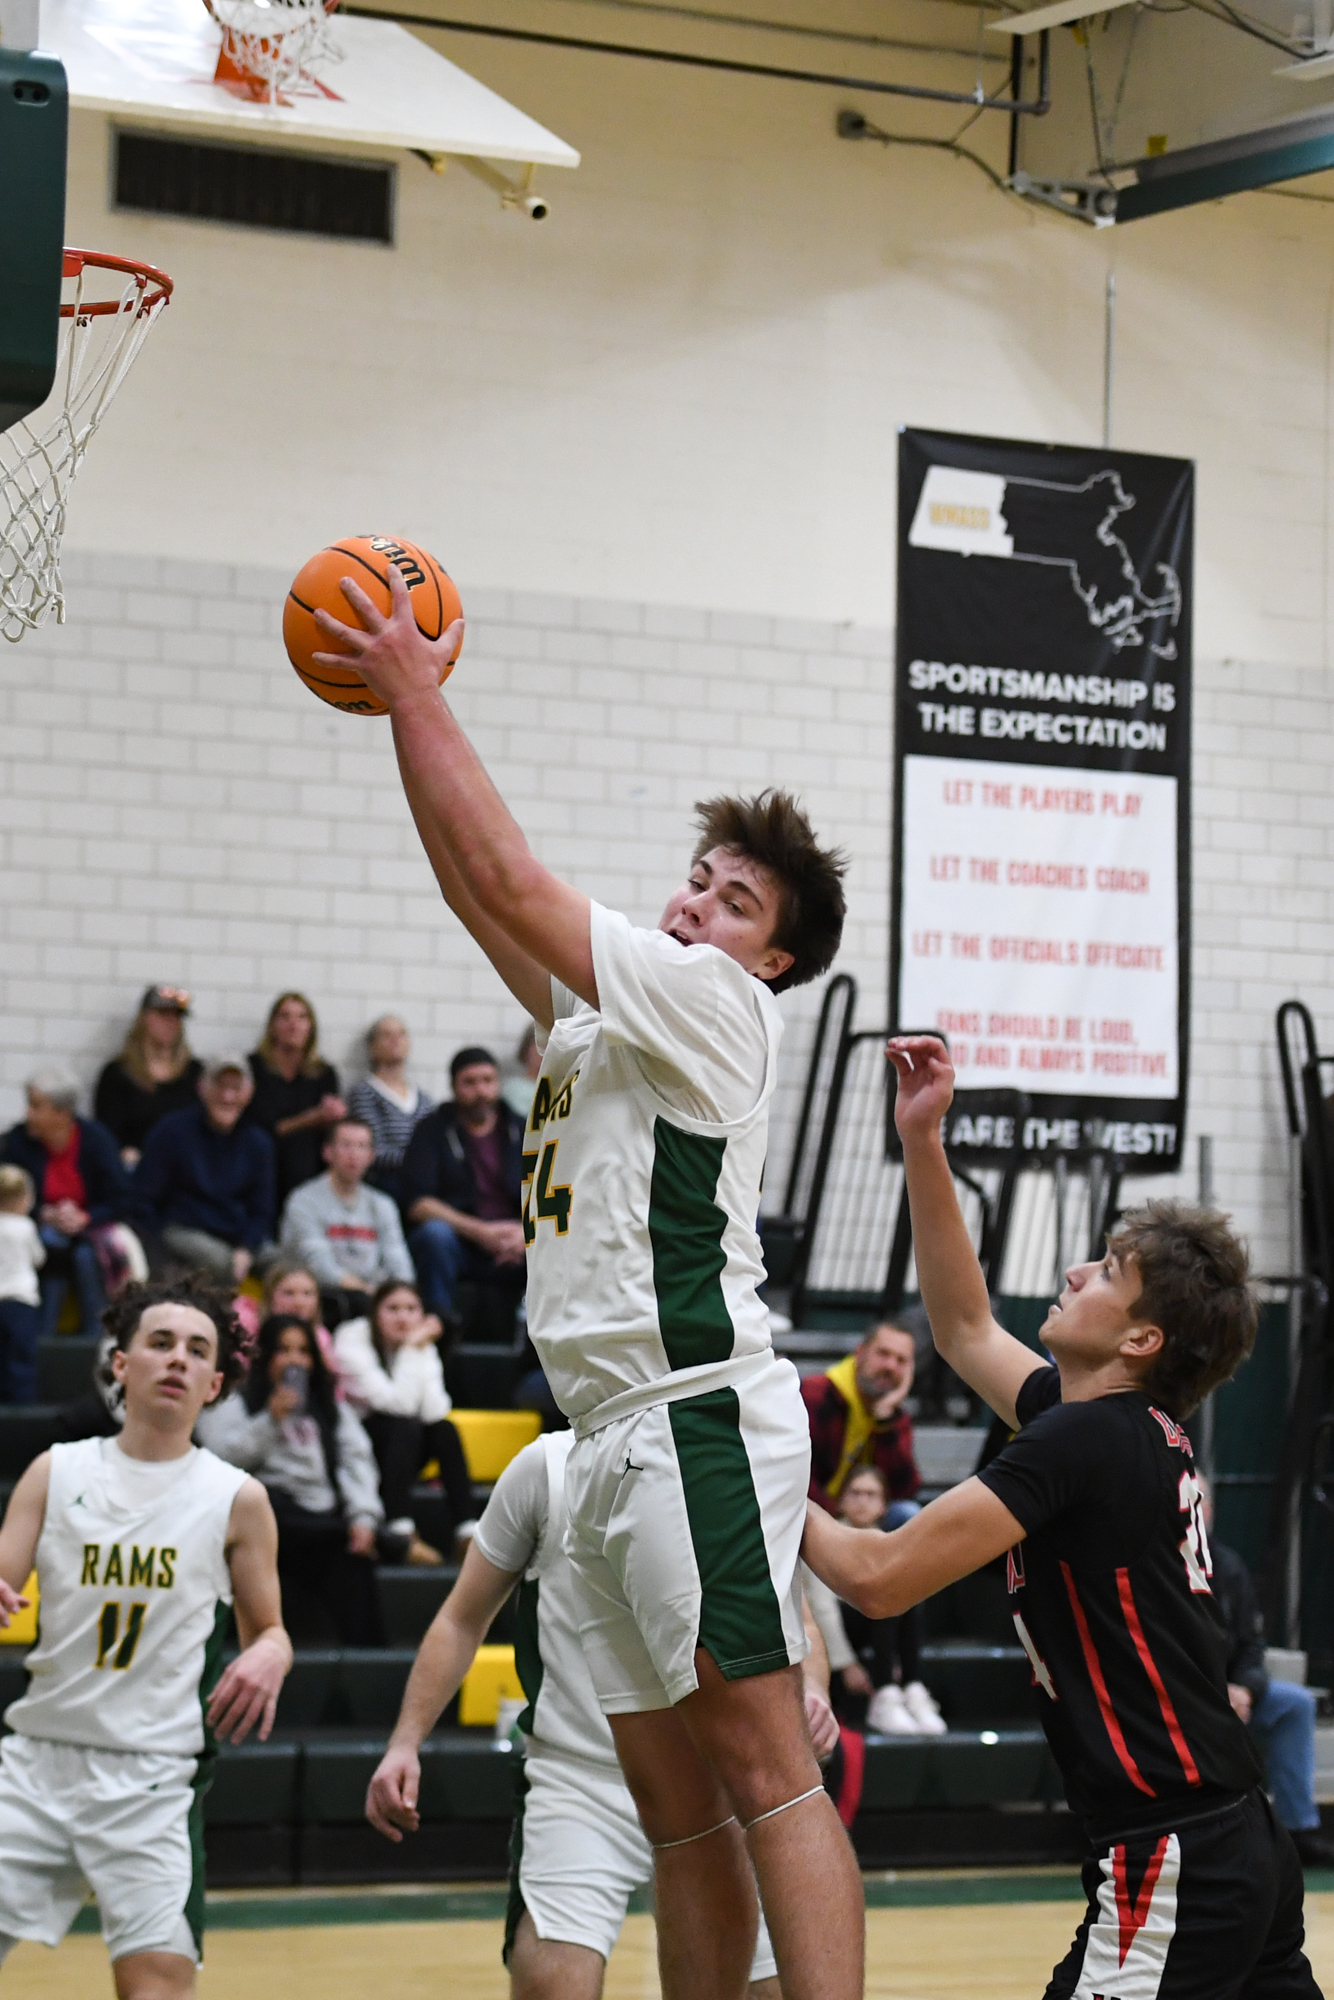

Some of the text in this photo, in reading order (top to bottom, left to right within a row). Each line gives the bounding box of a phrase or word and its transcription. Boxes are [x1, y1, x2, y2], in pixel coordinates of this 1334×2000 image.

[908, 659, 1176, 712] SPORTSMANSHIP IS
[918, 701, 1167, 751] THE EXPECTATION
[943, 779, 1143, 818] LET THE PLAYERS PLAY
[930, 855, 1149, 894] LET THE COACHES COACH
[912, 930, 942, 957] LET
[951, 933, 981, 960] THE
[989, 935, 1078, 966] OFFICIALS
[937, 1008, 980, 1036] FANS
[988, 1012, 1059, 1041] SHOULD
[1064, 1016, 1082, 1042] BE
[974, 1045, 1010, 1069] AND
[1019, 1047, 1084, 1074] ALWAYS
[950, 1114, 1015, 1148] ARE
[1023, 1116, 1080, 1150] THE
[81, 1543, 177, 1589] RAMS
[93, 1601, 149, 1671] 11
